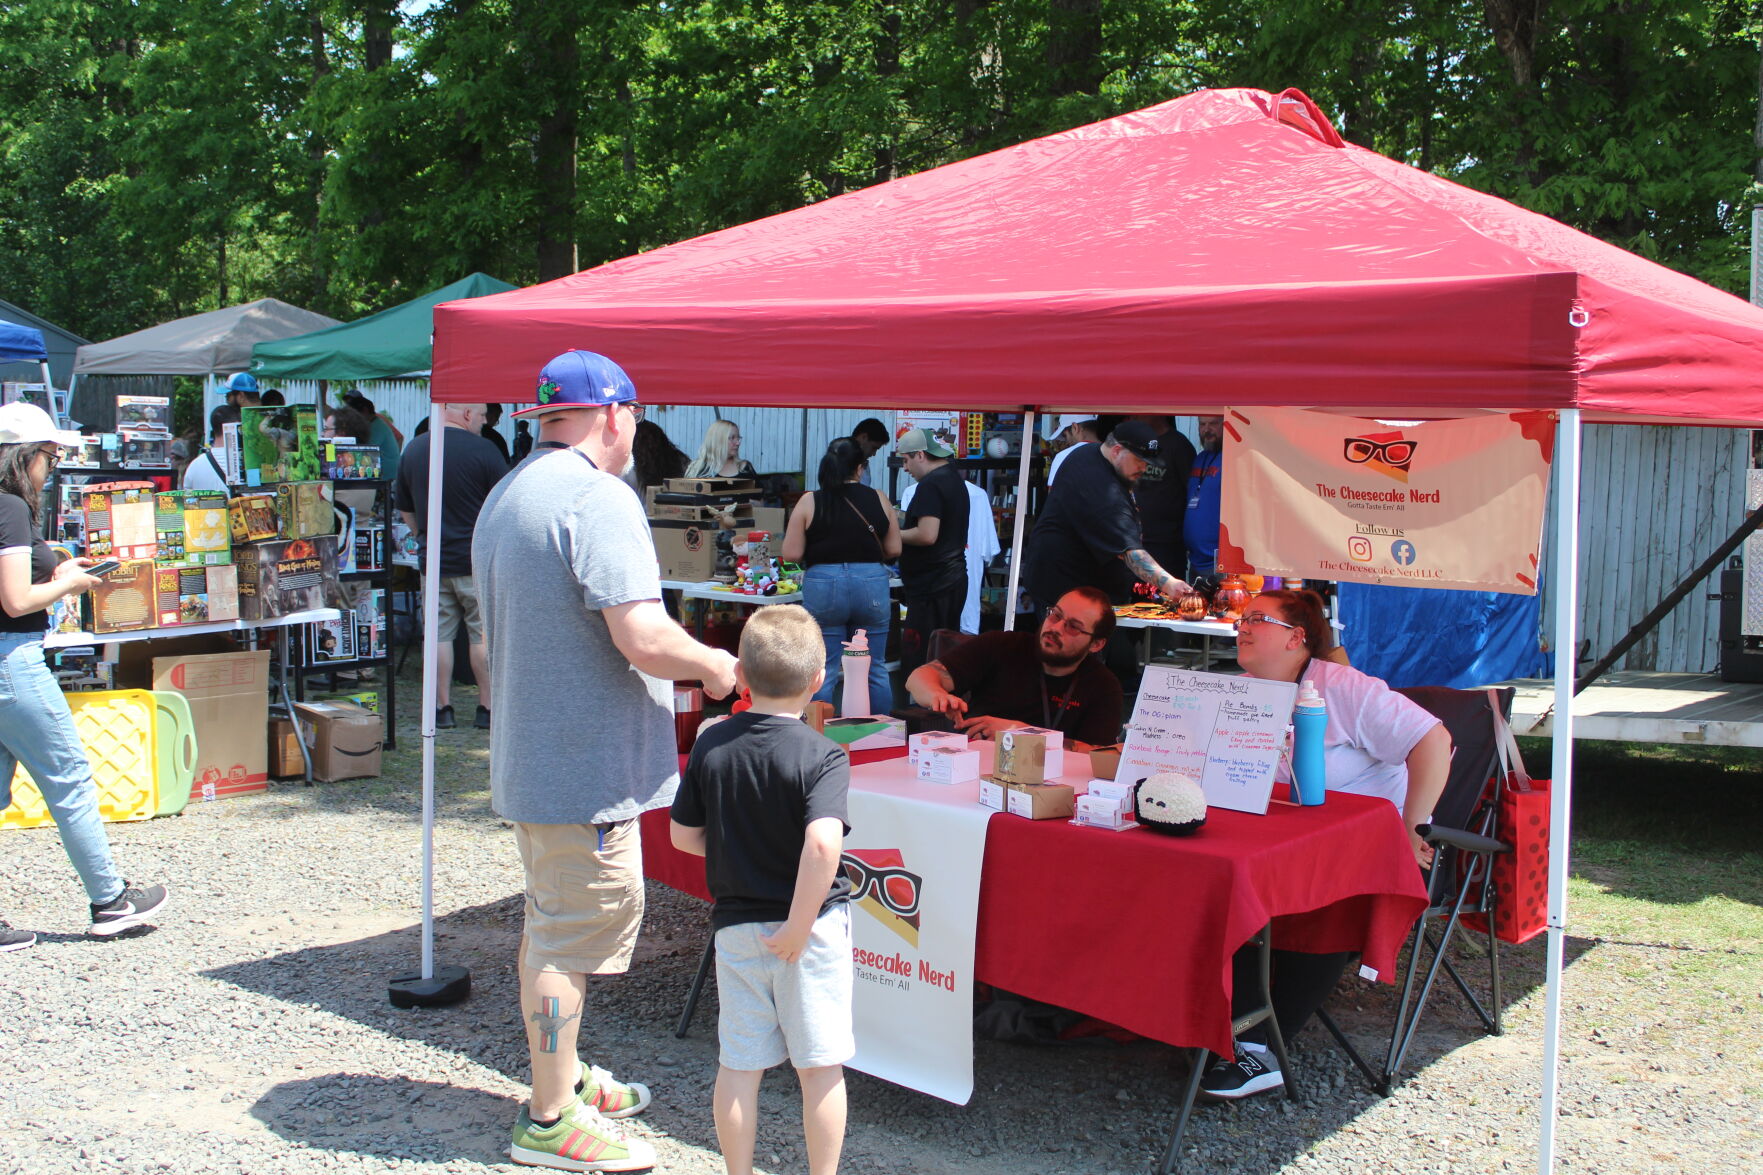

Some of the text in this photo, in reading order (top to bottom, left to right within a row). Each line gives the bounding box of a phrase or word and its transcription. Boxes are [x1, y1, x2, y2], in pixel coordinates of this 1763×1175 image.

[1146, 464, 1166, 476] City
[1316, 484, 1440, 504] The Cheesecake Nerd
[1356, 524, 1388, 535] Follow
[1319, 560, 1442, 578] The Cheesecake Nerd LLC
[1170, 674, 1244, 692] The Cheesecake Nerd
[1143, 692, 1170, 701] Cheesecake
[852, 948, 954, 992] esecake Nerd
[856, 968, 878, 982] Taste
[898, 980, 910, 992] All
